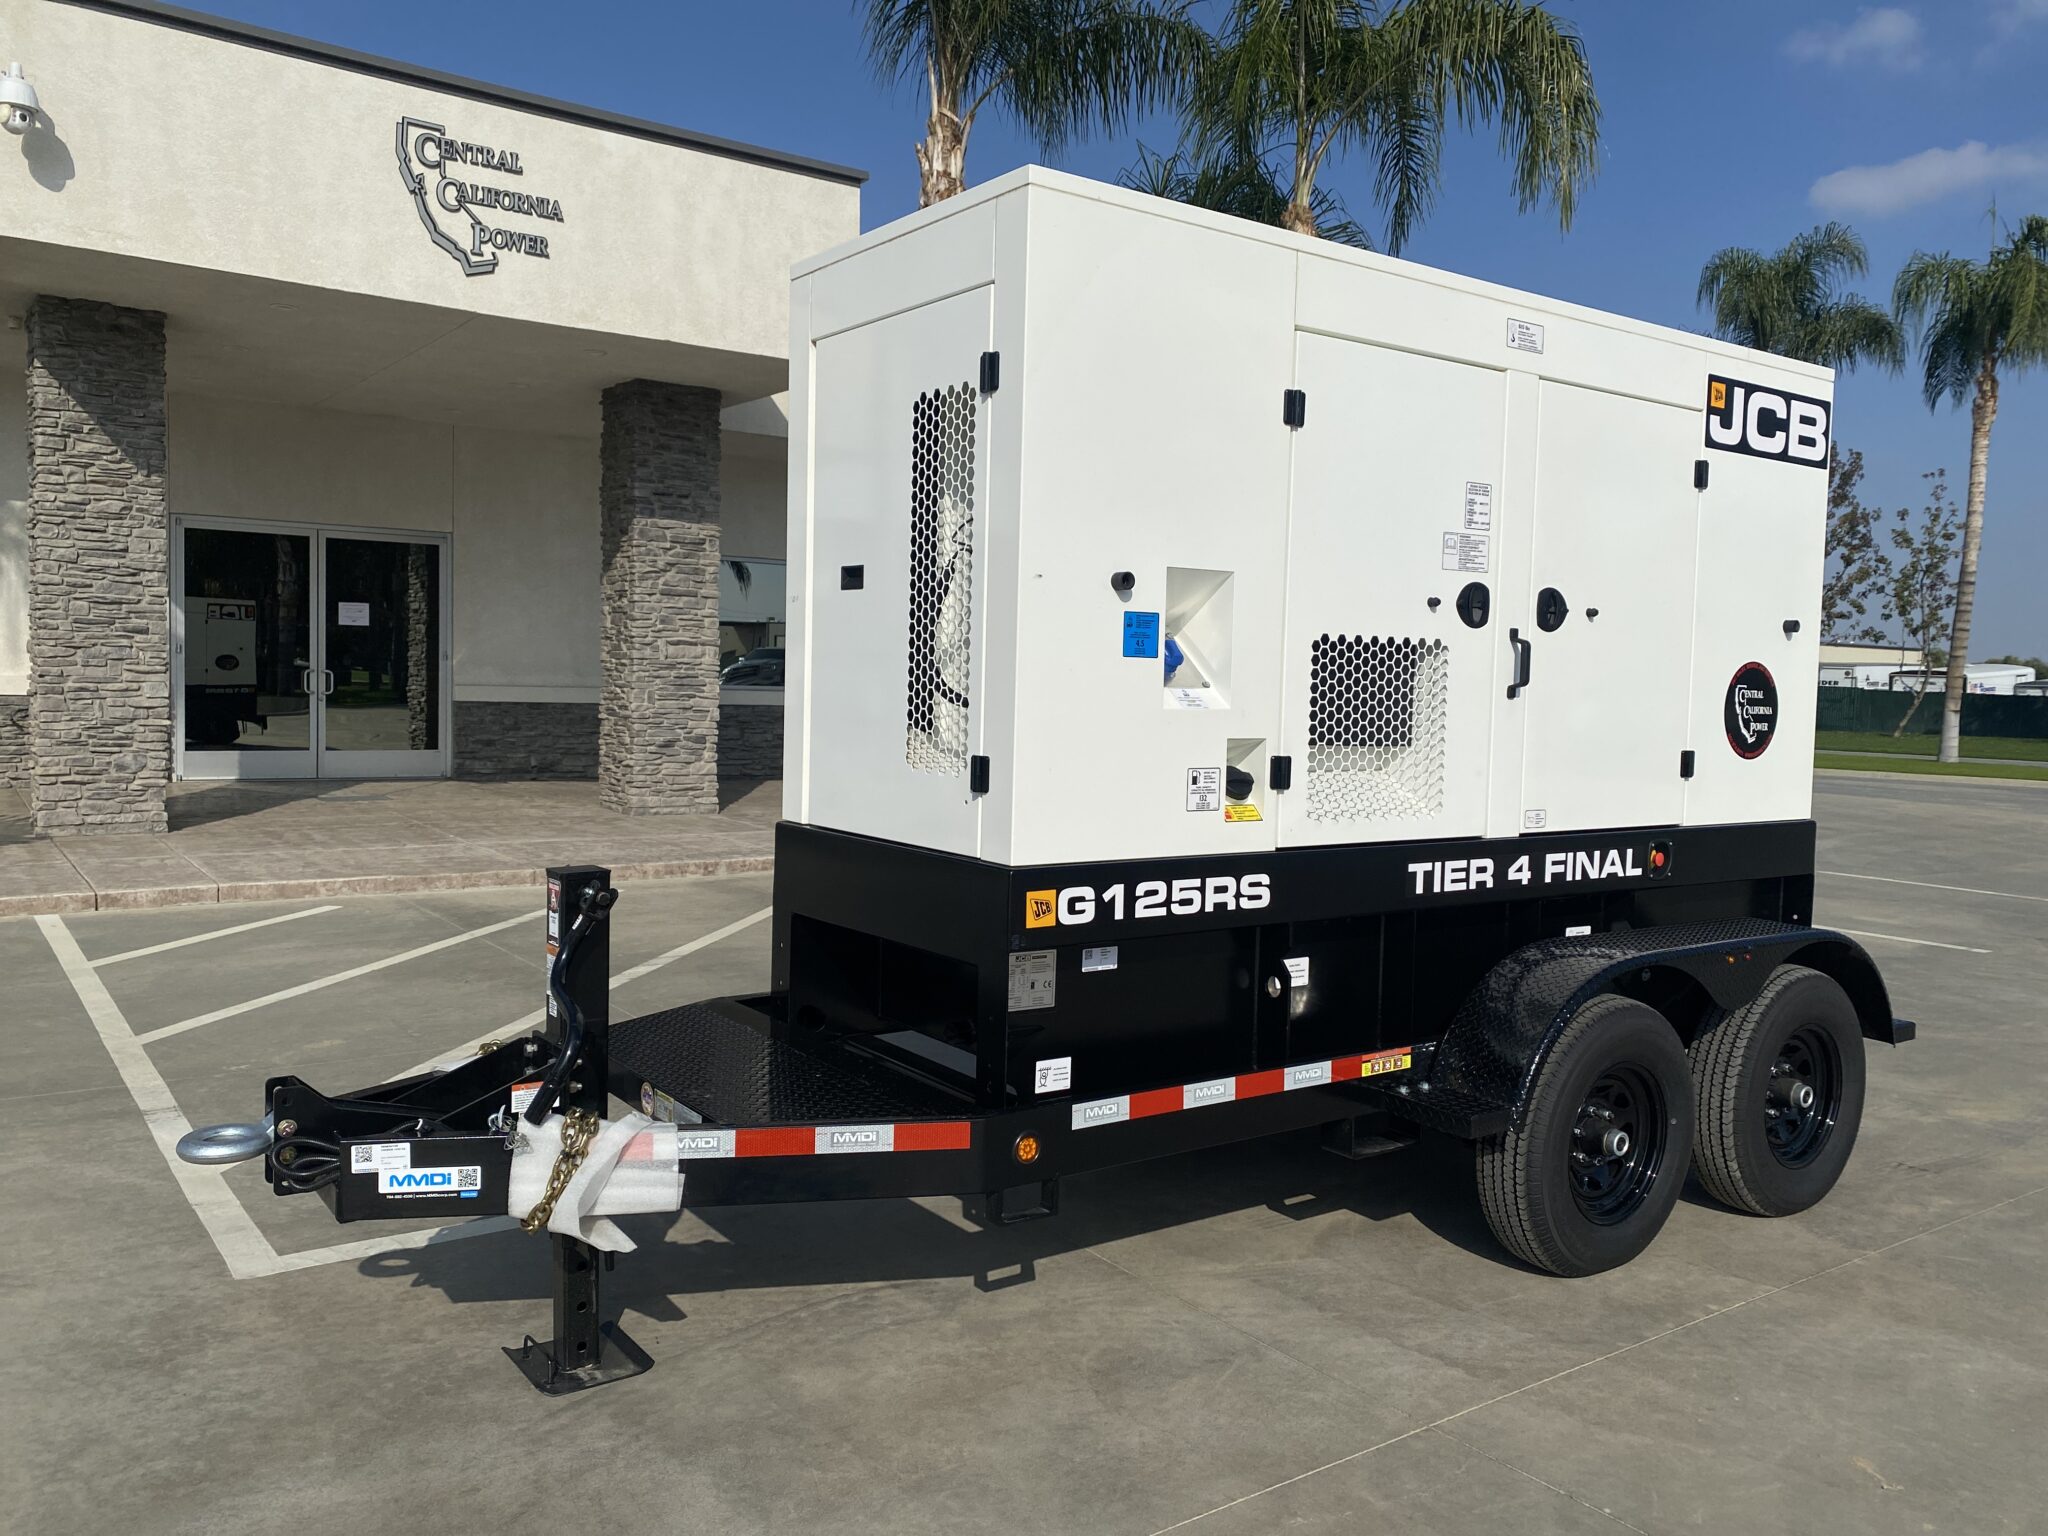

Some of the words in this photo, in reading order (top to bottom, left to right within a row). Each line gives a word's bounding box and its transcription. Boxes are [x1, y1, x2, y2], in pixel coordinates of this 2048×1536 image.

[414, 132, 523, 175] CENTRAL
[435, 176, 564, 223] CALIFORNIA
[470, 222, 550, 259] POWER
[1709, 386, 1827, 461] JCB
[1408, 858, 1494, 894] TIER
[1507, 855, 1532, 885] 4
[1544, 848, 1643, 883] FINAL
[1034, 901, 1052, 918] JCB
[1057, 873, 1271, 926] G125RS
